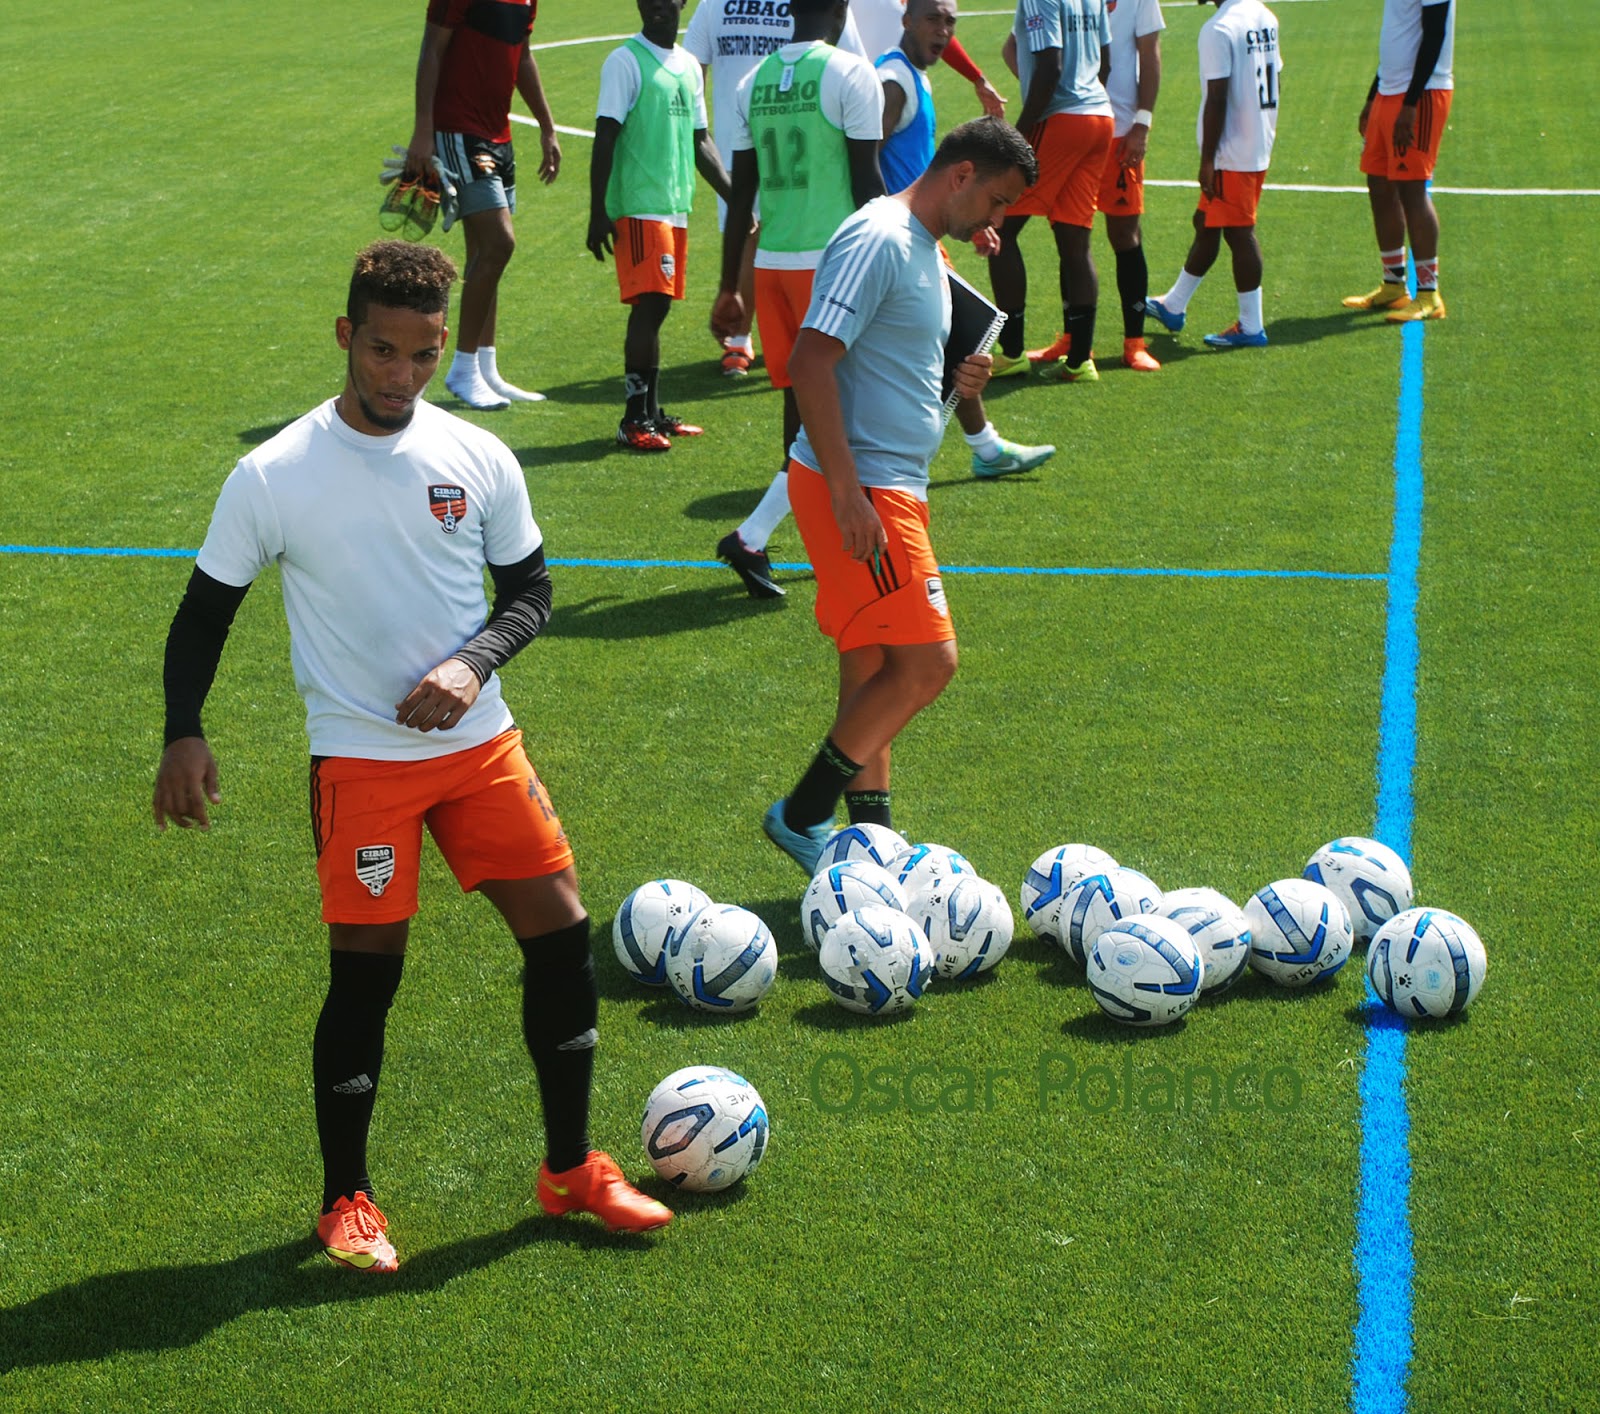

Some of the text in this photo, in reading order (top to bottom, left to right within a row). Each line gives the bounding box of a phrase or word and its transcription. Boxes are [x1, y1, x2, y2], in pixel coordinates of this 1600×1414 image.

[724, 0, 790, 17] CIBAO
[723, 17, 790, 27] FUTBOL CLUB
[752, 36, 789, 56] DEPORT
[762, 126, 808, 191] 12
[433, 487, 462, 495] CIBAO
[362, 848, 390, 858] CIBAO
[942, 954, 957, 979] ME
[1287, 943, 1342, 981] KELME
[726, 1092, 751, 1106] ME
